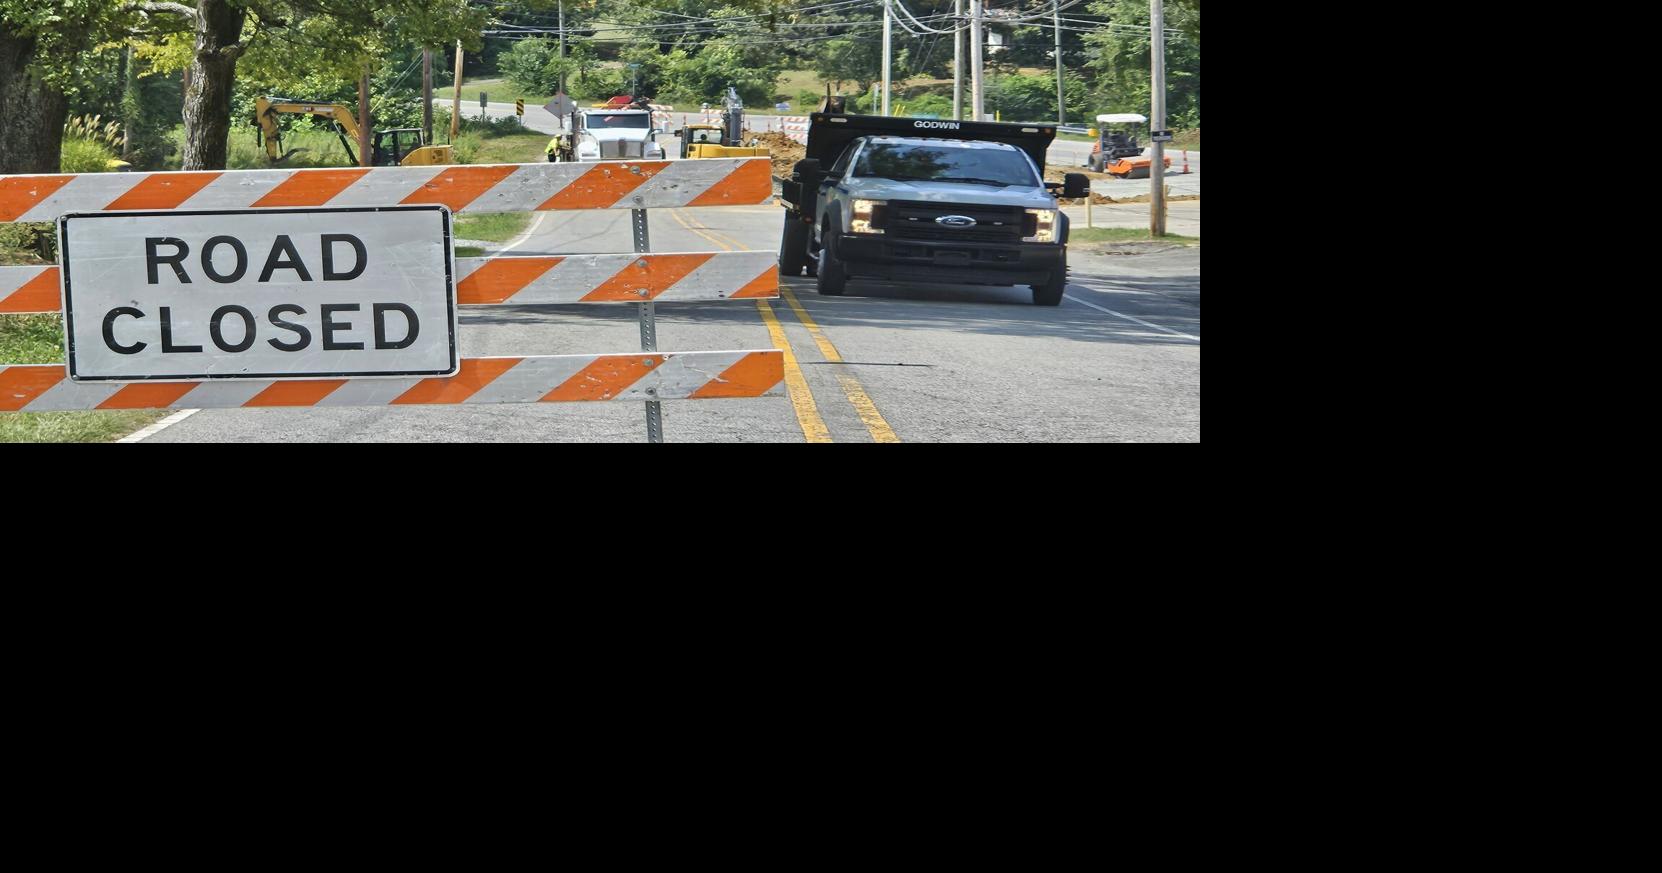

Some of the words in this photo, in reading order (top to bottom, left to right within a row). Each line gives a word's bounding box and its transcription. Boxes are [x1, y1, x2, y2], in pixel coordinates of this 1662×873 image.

[913, 120, 960, 130] GODWIN
[145, 233, 369, 285] ROAD
[101, 302, 420, 354] CLOSED
